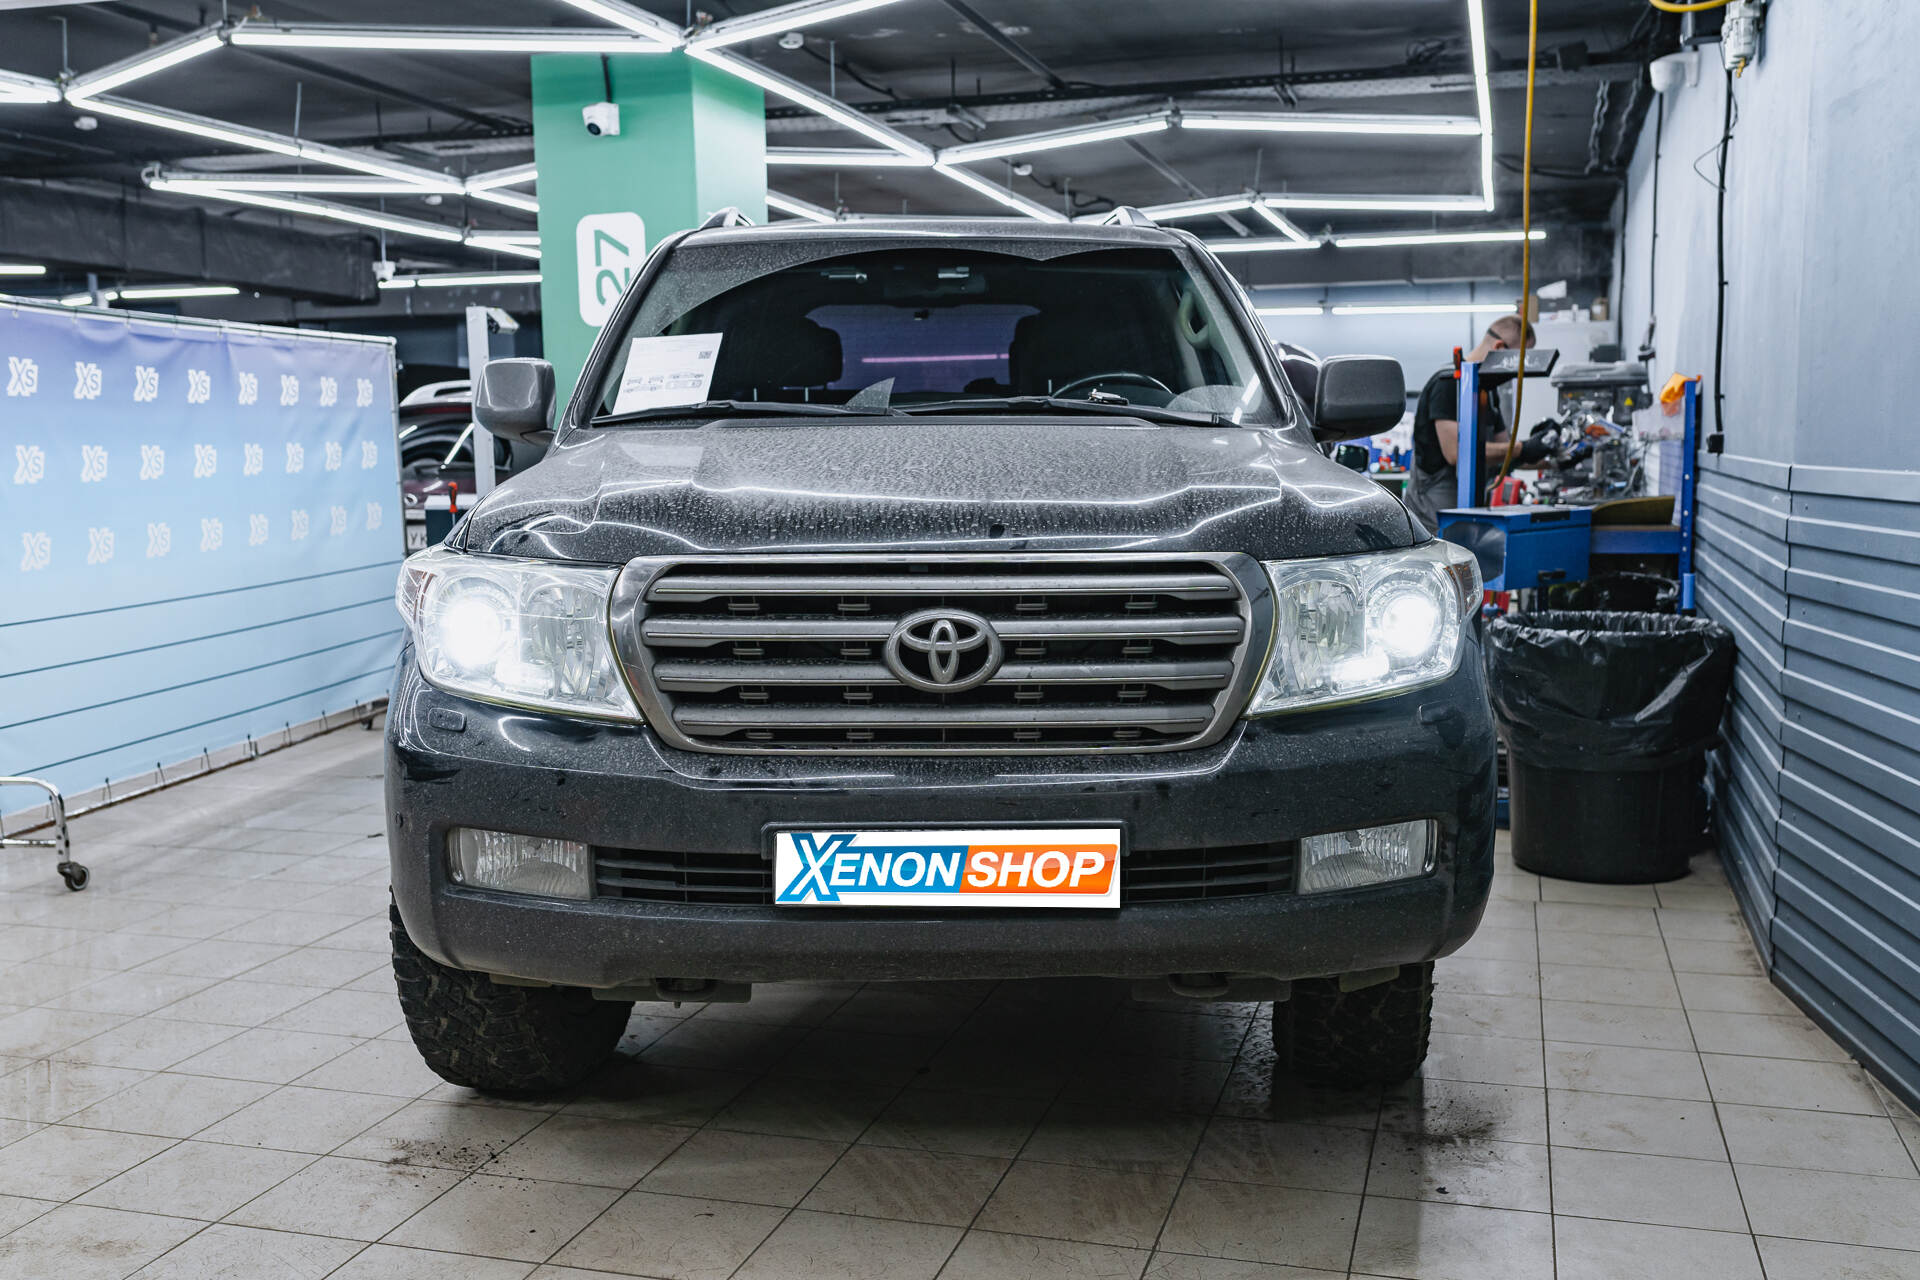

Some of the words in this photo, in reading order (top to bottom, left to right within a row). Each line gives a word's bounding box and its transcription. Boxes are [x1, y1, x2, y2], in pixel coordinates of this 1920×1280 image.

[593, 228, 631, 307] 27
[788, 838, 963, 897] XENON
[966, 850, 1106, 889] SHOP
